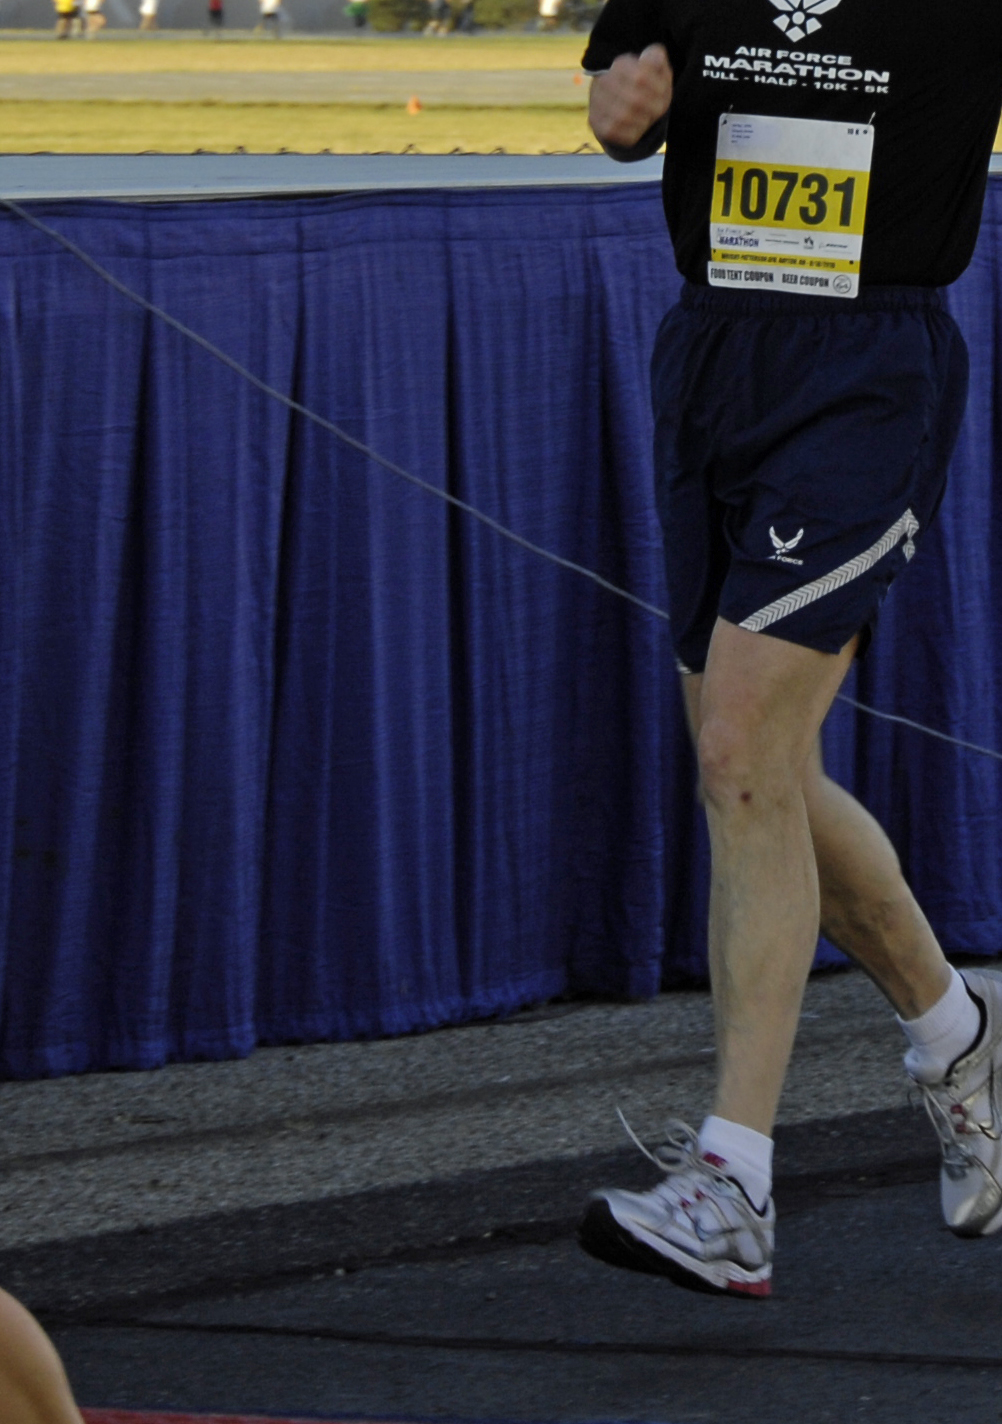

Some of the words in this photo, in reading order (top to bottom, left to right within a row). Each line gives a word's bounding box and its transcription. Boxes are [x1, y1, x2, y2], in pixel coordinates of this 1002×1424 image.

[735, 45, 772, 59] AIR
[776, 49, 853, 66] FORCE
[704, 54, 890, 83] MARATHON
[702, 69, 739, 81] FULL
[754, 74, 798, 87] HALF
[813, 81, 847, 91] 10K
[864, 84, 889, 94] 5K
[716, 166, 856, 227] 10731
[727, 269, 743, 280] TENT
[744, 270, 774, 282] COUPON
[799, 275, 829, 287] COUPON
